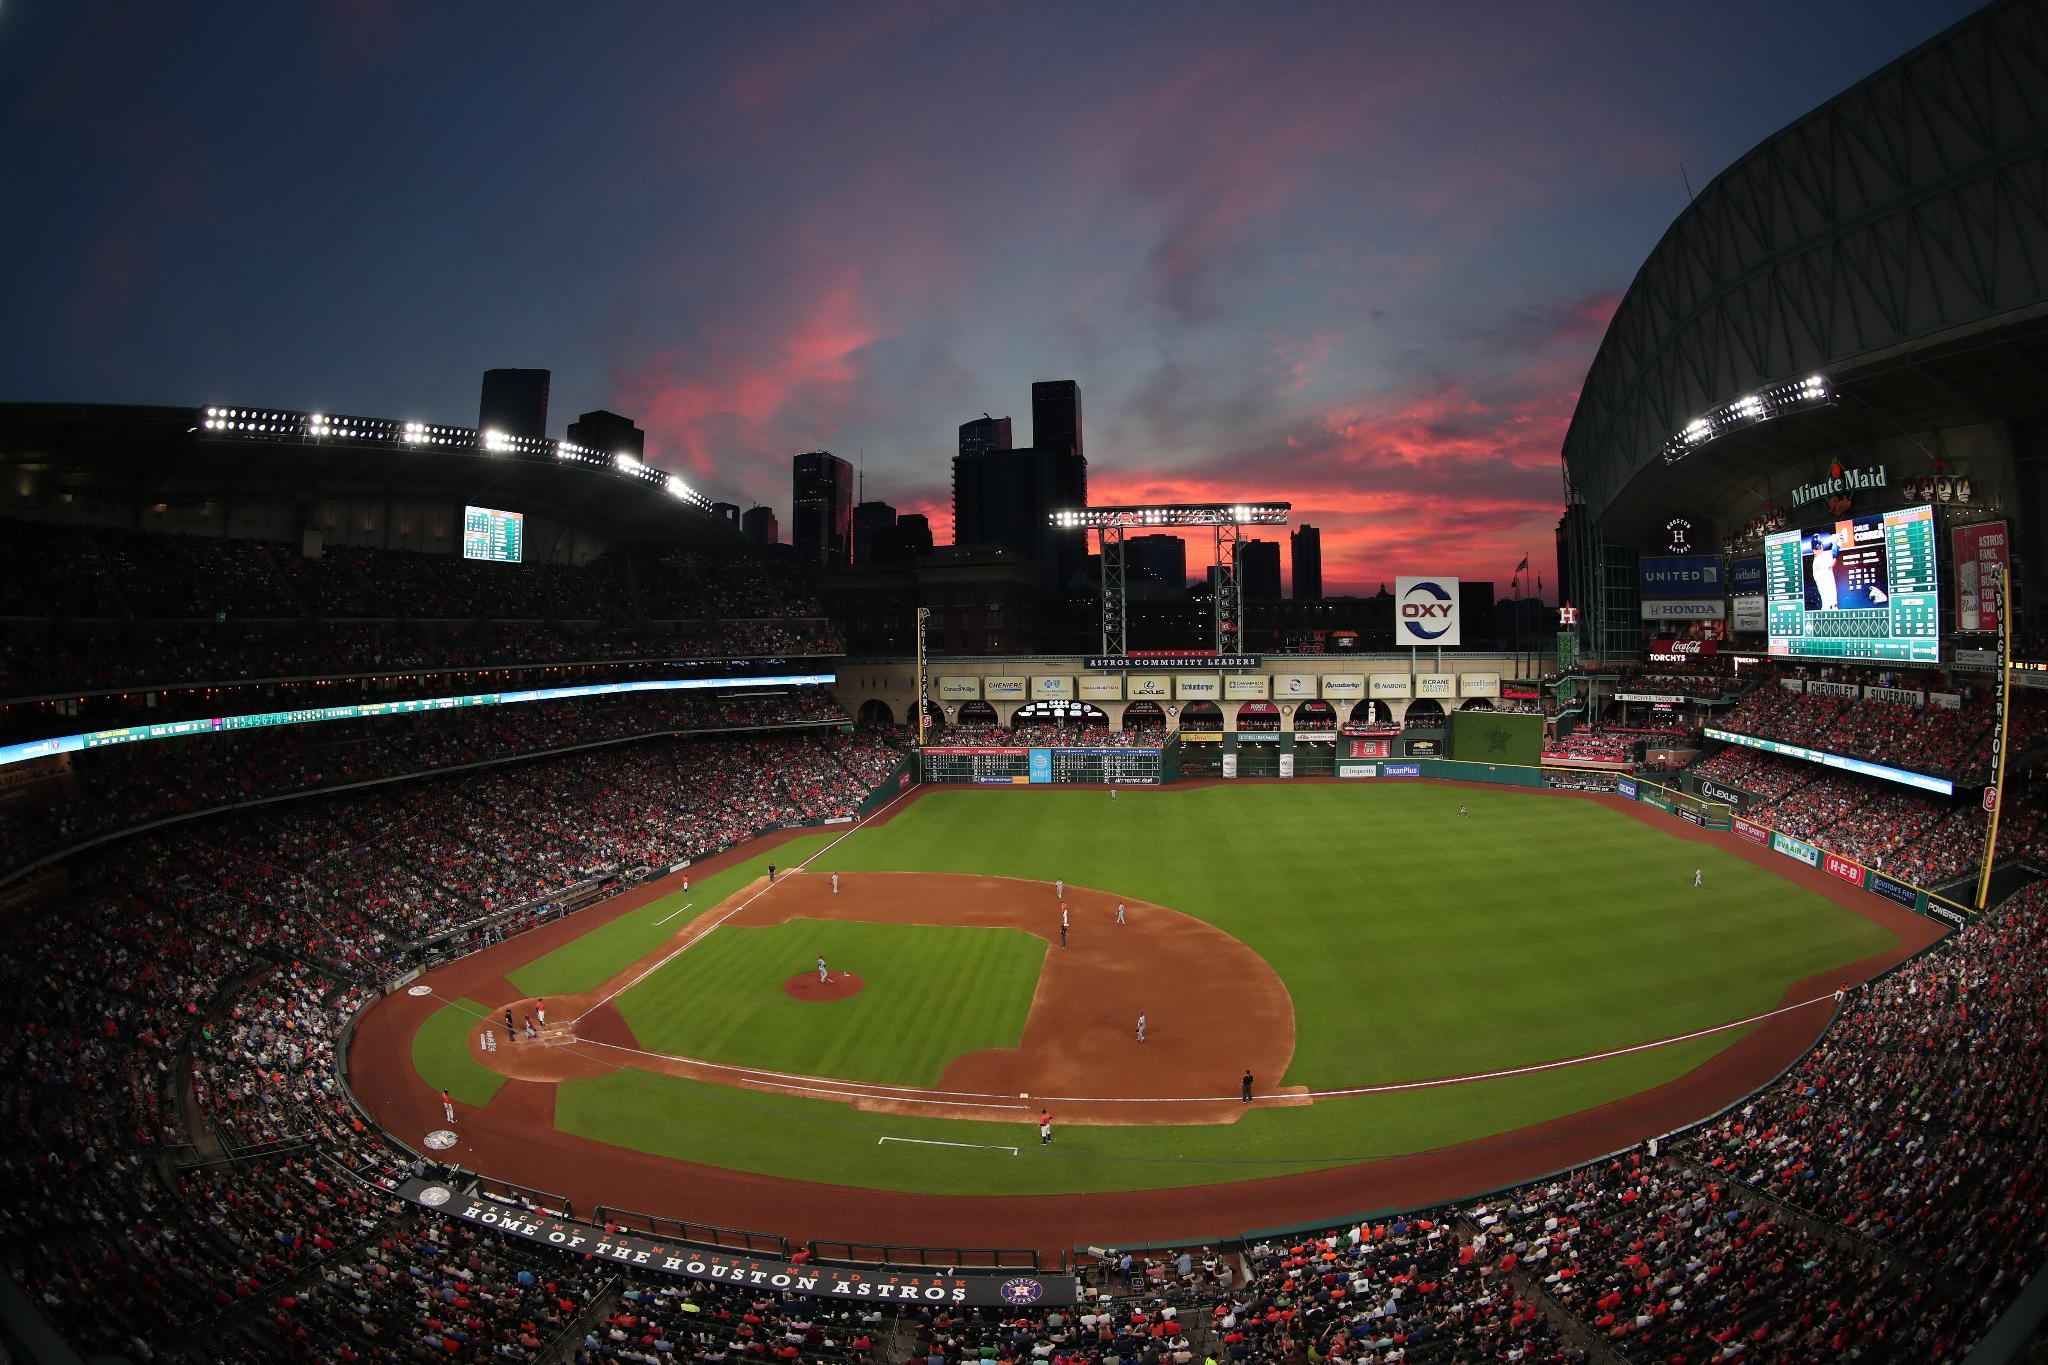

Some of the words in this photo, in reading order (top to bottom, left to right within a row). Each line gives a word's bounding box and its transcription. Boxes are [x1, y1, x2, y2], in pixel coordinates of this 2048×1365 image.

[1791, 477, 1842, 508] Minute
[1844, 465, 1887, 490] Maid
[1666, 518, 1692, 530] HOUSTON
[1673, 530, 1685, 542] H
[1854, 530, 1884, 542] CORREA
[1978, 534, 2004, 548] ASTROS
[1646, 571, 1700, 582] UNITED
[1982, 588, 1994, 600] FOR
[1402, 604, 1453, 618] OXY
[1663, 605, 1717, 614] HONDA
[1982, 602, 1995, 613] YOU
[1560, 608, 1576, 624] H
[1996, 594, 2004, 697] BURGERZ
[1650, 654, 1686, 662] TORCHYS
[1812, 682, 1854, 698] CHEVROLET
[1871, 689, 1917, 704] SILVERADO
[1991, 723, 2002, 784] FOUL
[1619, 783, 1635, 796] GEICO
[1712, 788, 1738, 803] LEXUS
[1736, 821, 1749, 831] ROOT
[1749, 827, 1765, 838] SPORTS
[1777, 840, 1789, 850] EVA
[1790, 846, 1802, 855] AIR
[1874, 878, 1900, 894] HOUSTON'S
[1902, 890, 1916, 900] FIRST
[473, 1201, 582, 1235] WELCOME
[601, 1236, 628, 1246] TO
[652, 1246, 760, 1270] MINUTE
[786, 1267, 861, 1281] MAID
[890, 1277, 967, 1287] PARK
[462, 1207, 539, 1235] HOME
[548, 1231, 586, 1248] OF
[595, 1242, 651, 1264] THE
[662, 1257, 818, 1290] HOUSTON
[832, 1281, 966, 1301] ASTROS
[1015, 1286, 1029, 1296] H
